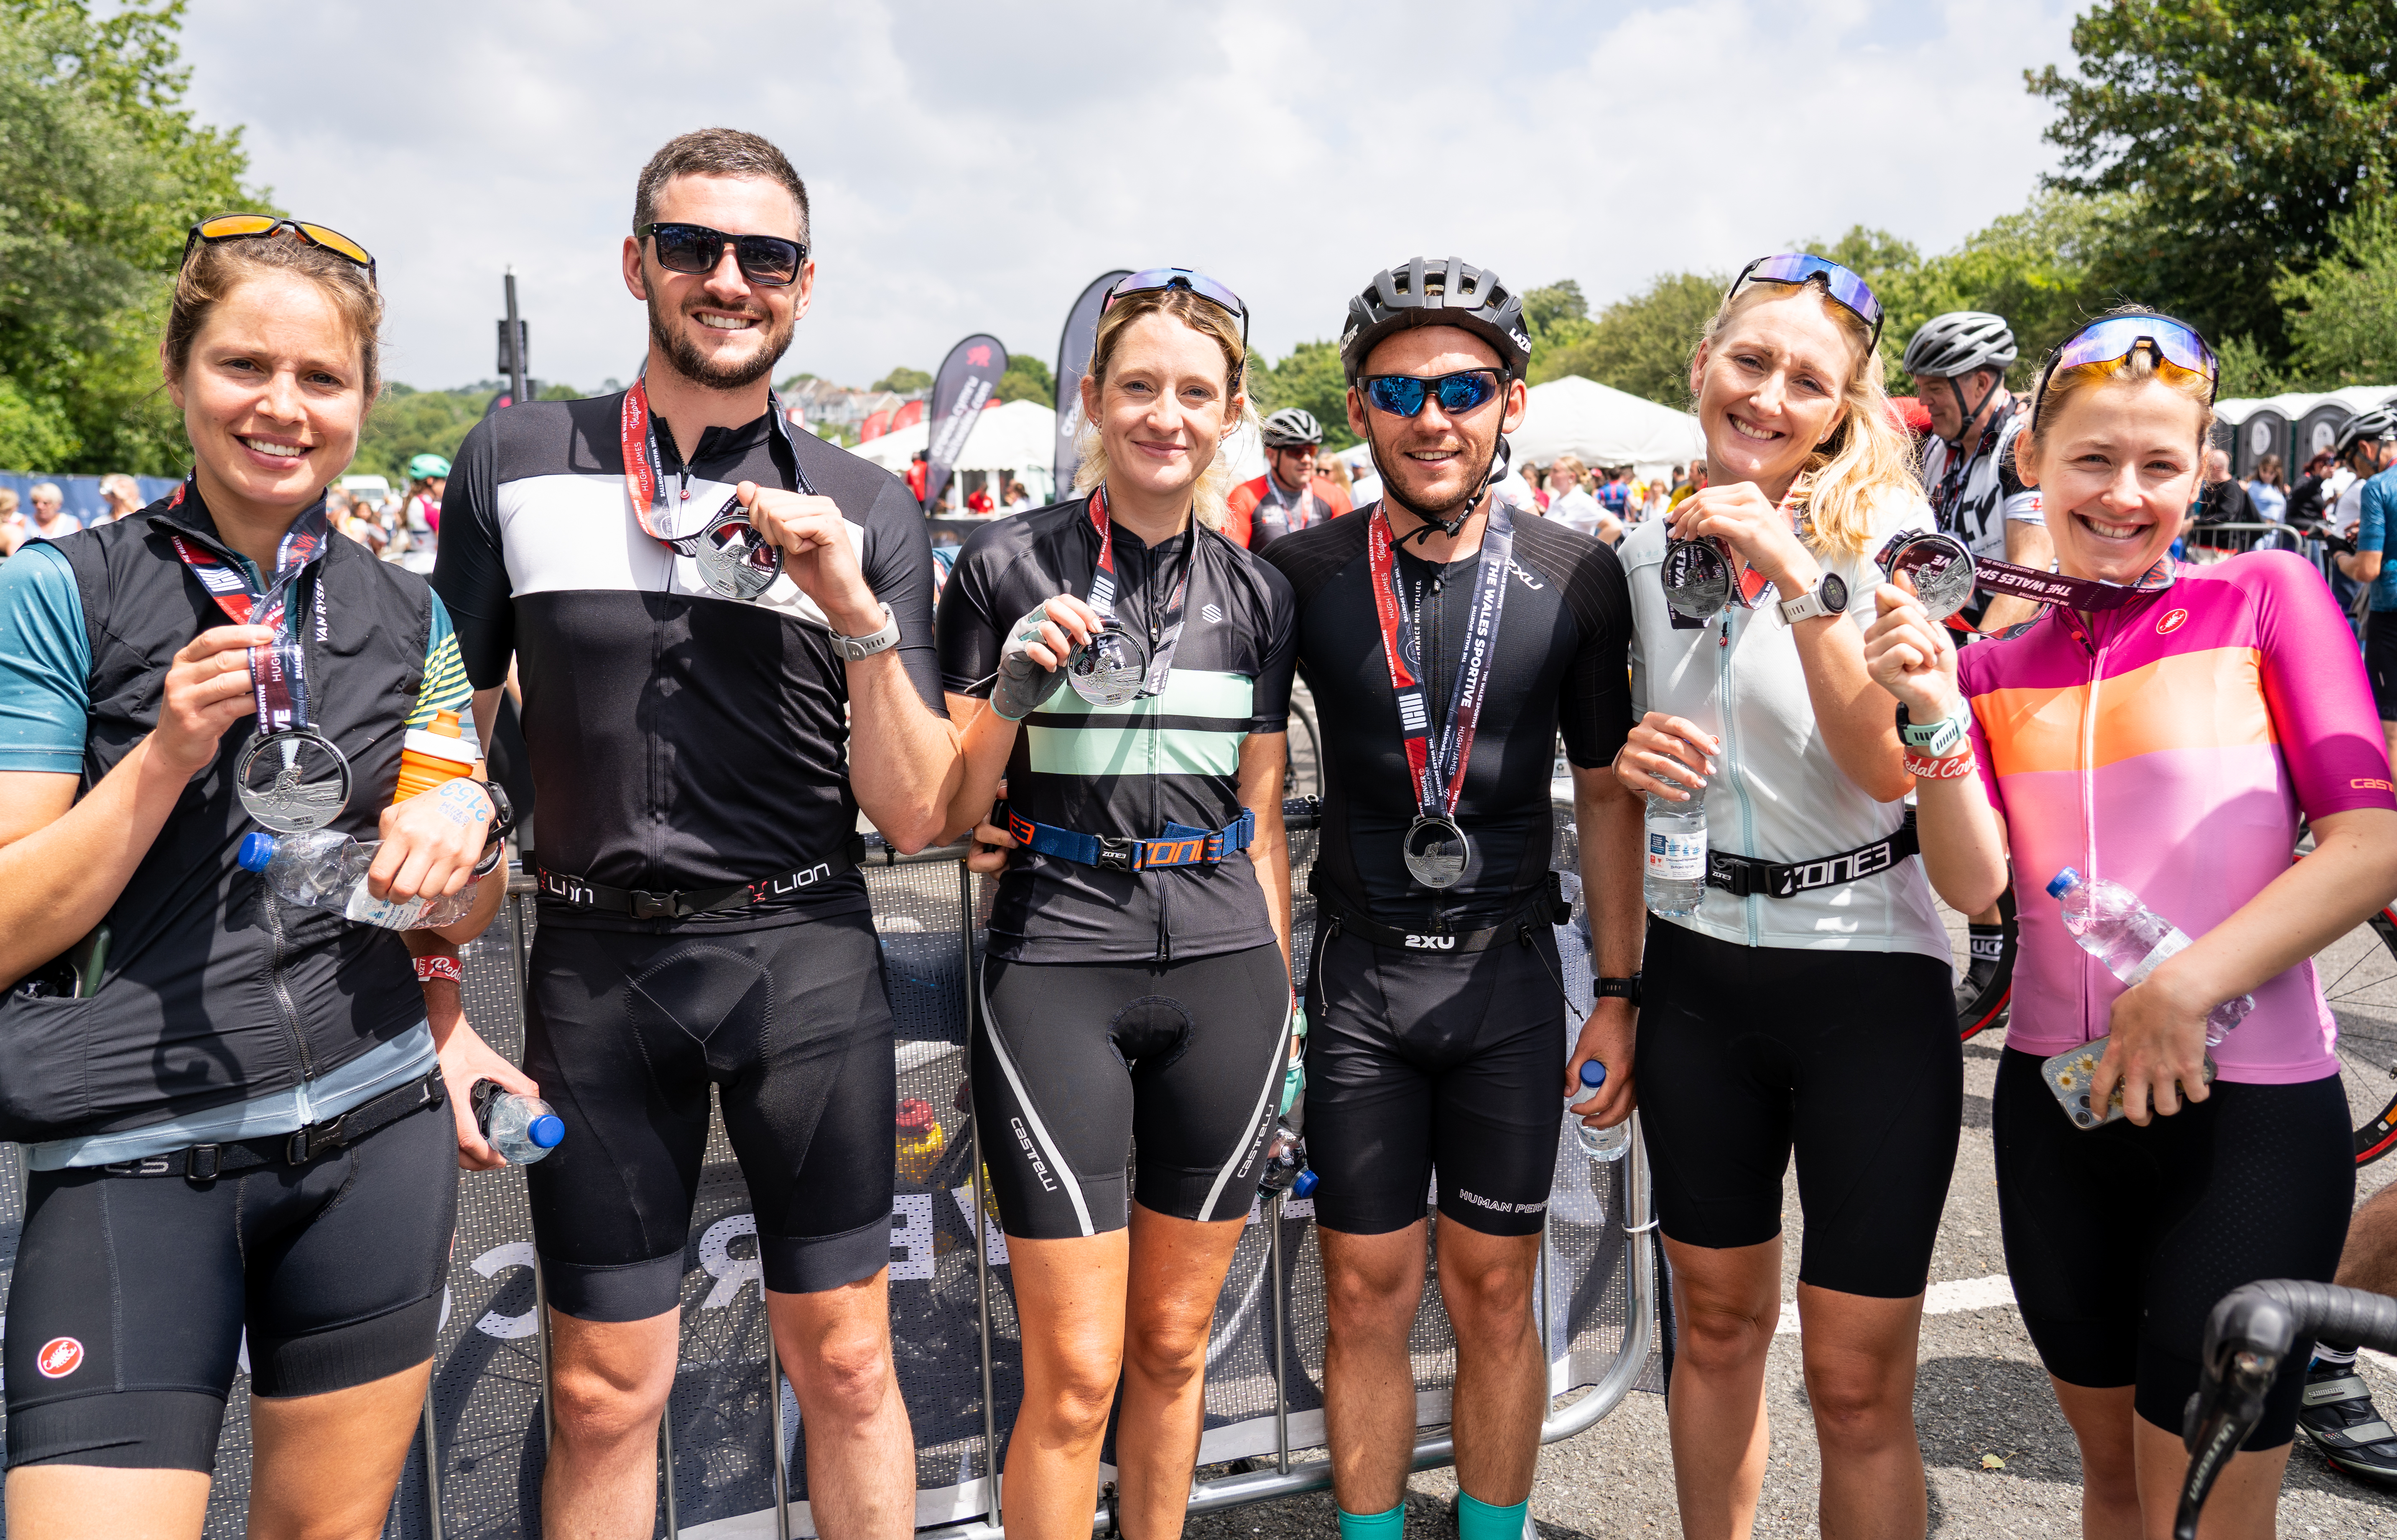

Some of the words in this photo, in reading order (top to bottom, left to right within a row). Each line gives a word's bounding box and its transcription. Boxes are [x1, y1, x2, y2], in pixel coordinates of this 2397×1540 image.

[1339, 324, 1359, 353] LAZER
[1509, 328, 1532, 354] LAZER
[634, 442, 645, 465] JAMES
[640, 469, 648, 491] HUGH
[656, 469, 666, 497] SPORTIVE
[798, 468, 813, 494] SPORTIVE
[714, 512, 724, 522] THE
[723, 496, 739, 512] WALES
[174, 540, 186, 554] WALES
[1486, 561, 1500, 586] THE
[1675, 549, 1686, 588] WALE
[1730, 568, 1739, 586] WALES
[1992, 560, 2010, 569] WALES
[2010, 565, 2035, 574] SPORTIVE
[1382, 573, 1391, 594] JAMES
[1764, 581, 1773, 593] THE
[1997, 573, 2047, 592] WALES
[2045, 584, 2073, 597] THE
[315, 578, 327, 615] RYSE
[1386, 598, 1395, 619] HUGH
[1497, 584, 1505, 609] SPORTIVE
[2017, 592, 2042, 601] SPORTIVE
[1400, 597, 1409, 623] SPORTIVE
[1468, 606, 1477, 631] SPORTIVE
[1477, 589, 1496, 636] WALES
[273, 630, 286, 646] JAMES
[316, 617, 328, 642] VAN
[1382, 629, 1391, 655] SPORTIVE
[271, 650, 282, 682] HUGH
[1461, 638, 1486, 708] SPORTIVE
[1150, 669, 1163, 693] THE
[1450, 692, 1459, 711] WALES
[1455, 665, 1465, 692] SPORTIVE
[1477, 682, 1486, 701] WALES
[258, 684, 268, 723] SPORTIVE
[1471, 702, 1481, 728] SPORTIVE
[1441, 725, 1451, 751] SPORTIVE
[1456, 726, 1466, 748] HUGH
[1449, 751, 1459, 776] JAMES
[1903, 753, 1939, 778] edal
[1420, 775, 1431, 806] ERDINGER
[1425, 767, 1435, 805] ALKOHOLFREI
[1434, 770, 1443, 797] SPORTIVE
[2350, 779, 2394, 792] cast
[440, 783, 488, 822] 2153
[441, 802, 470, 822] SWIM
[1134, 839, 1223, 869] ZONE
[774, 863, 830, 894] LION
[1712, 871, 1731, 880] ZONE3
[1781, 841, 1891, 893] ZONE3
[1405, 935, 1454, 949] 2XU
[1459, 1189, 1512, 1212] HUMAN
[1515, 1199, 1549, 1213] PERF
[2308, 1386, 2344, 1397] SHIMANO
